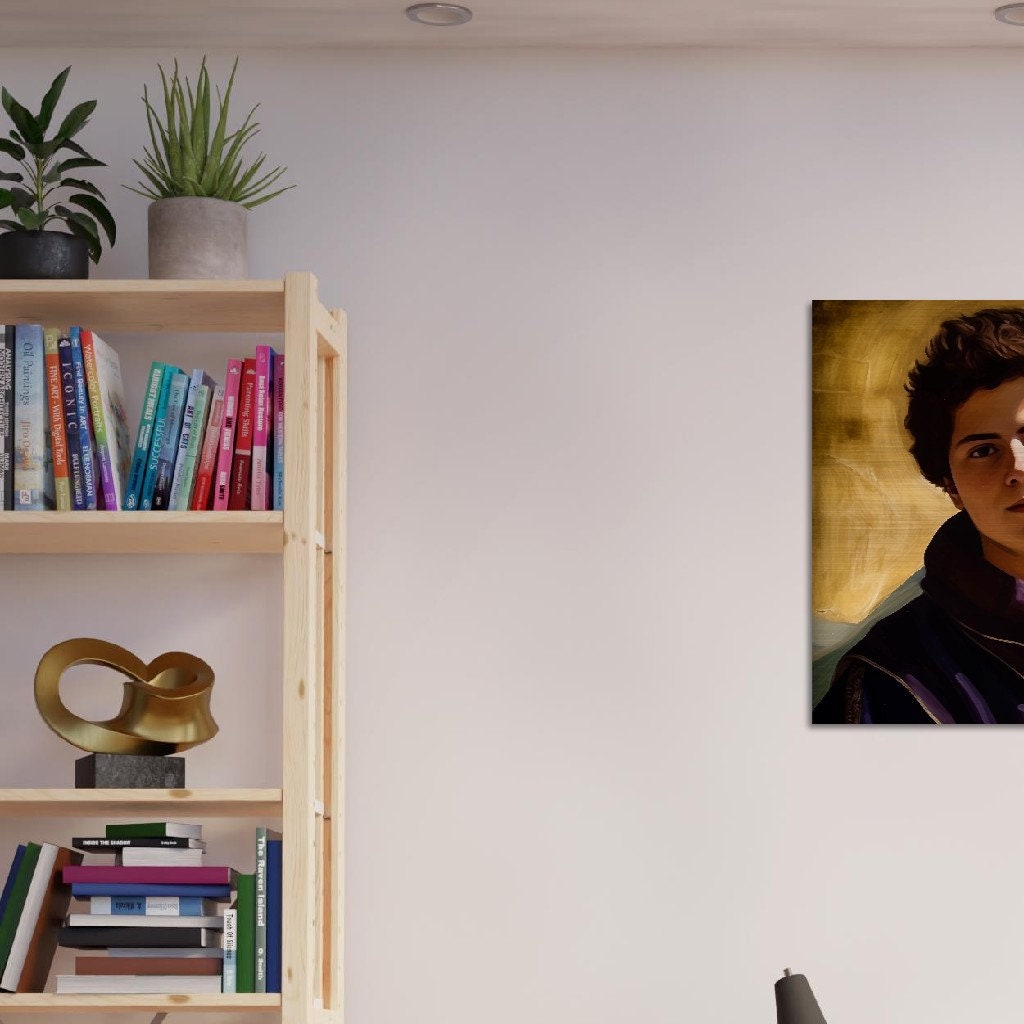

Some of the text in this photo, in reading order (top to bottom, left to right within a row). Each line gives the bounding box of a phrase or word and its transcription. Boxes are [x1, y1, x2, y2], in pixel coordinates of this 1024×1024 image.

[20, 342, 35, 405] Oil Paintings
[50, 380, 59, 398] ART
[62, 362, 77, 430] ICONIC
[83, 344, 104, 433] Watercolor Portraits
[52, 405, 61, 422] With
[241, 382, 253, 438] Parenting Skills
[80, 415, 88, 430] ART
[52, 424, 63, 447] Digital
[180, 433, 190, 450] CATS
[257, 835, 266, 927] The Raven Island
[226, 914, 234, 930] Touch
